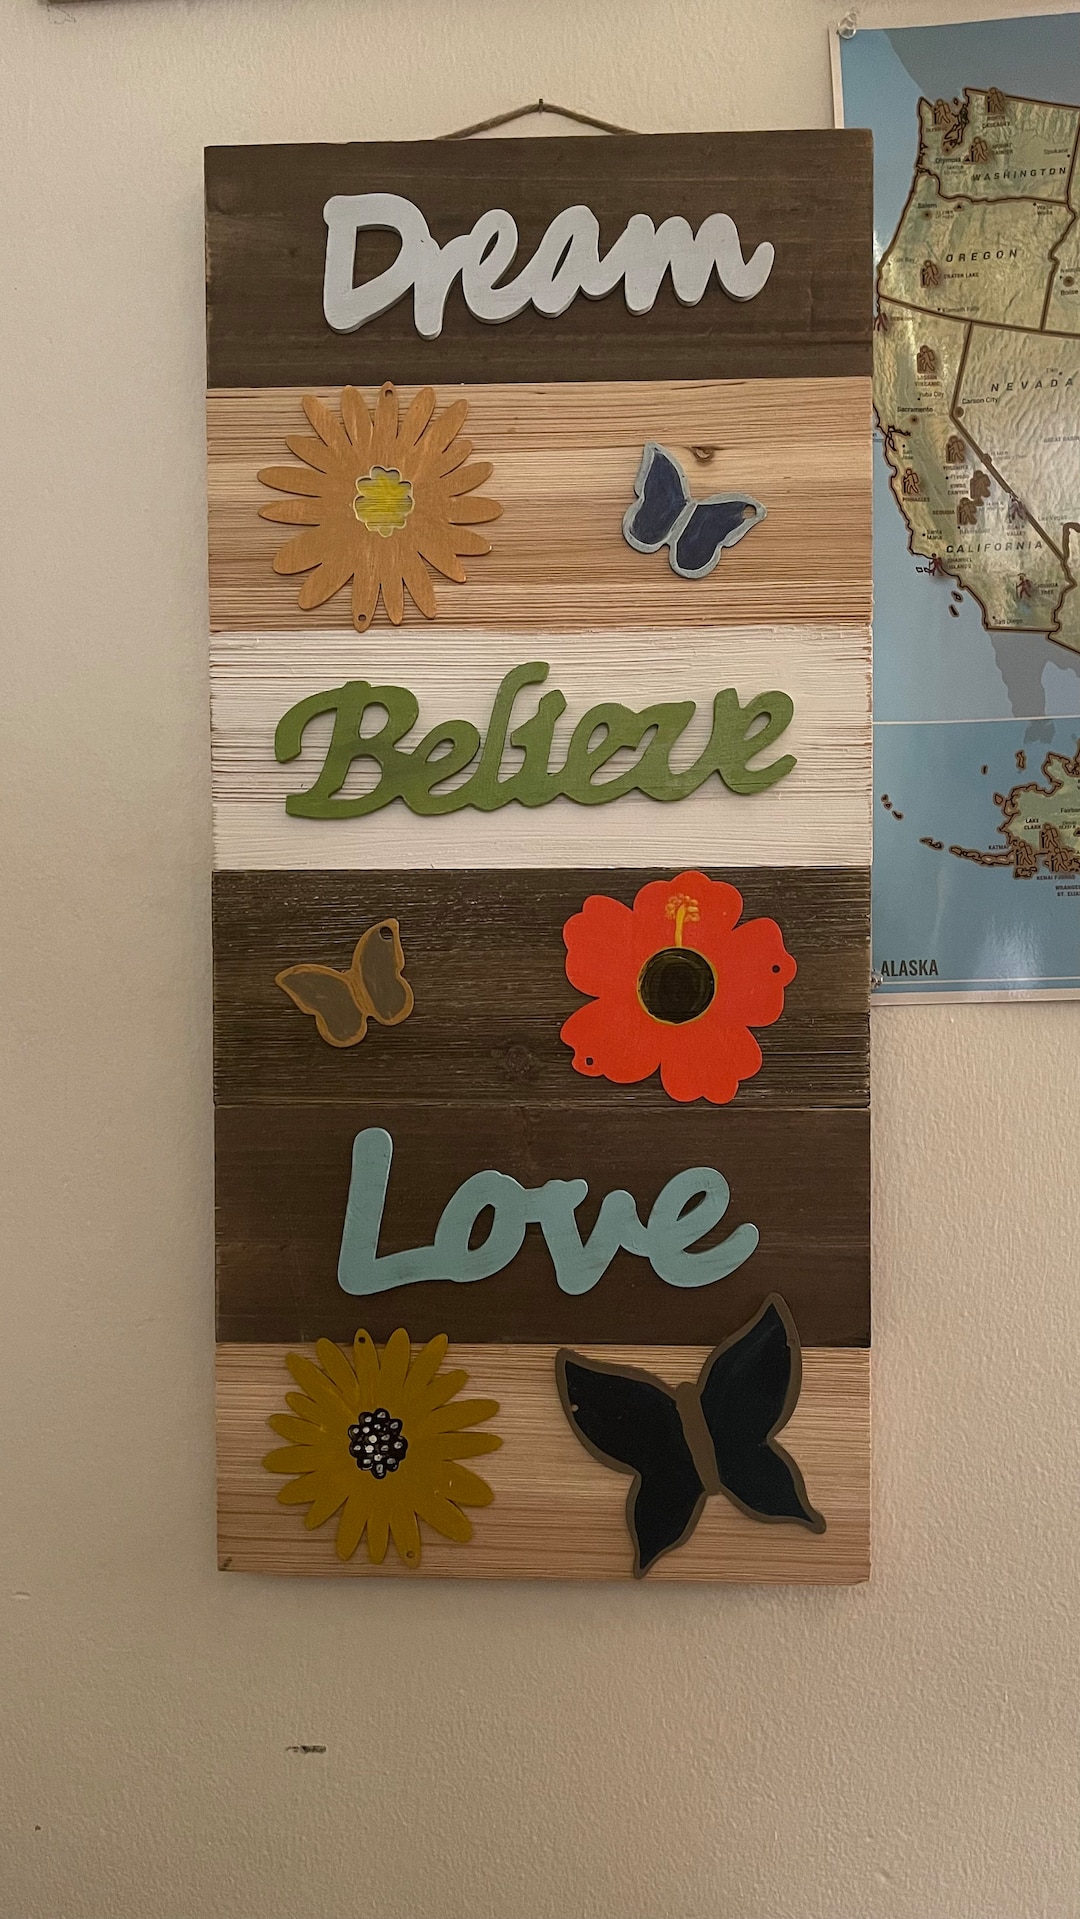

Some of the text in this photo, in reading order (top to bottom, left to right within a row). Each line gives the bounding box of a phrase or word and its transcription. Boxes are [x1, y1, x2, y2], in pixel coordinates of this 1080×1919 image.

[972, 167, 1067, 181] WASHINGTON
[945, 249, 1019, 263] OREGON
[323, 192, 775, 340] Dream
[990, 377, 1074, 393] NEVADA
[933, 391, 944, 399] City
[946, 541, 1044, 554] CALIFORNIA
[275, 661, 798, 820] Believe
[880, 959, 939, 977] ALASKA
[337, 1126, 760, 1296] Love
